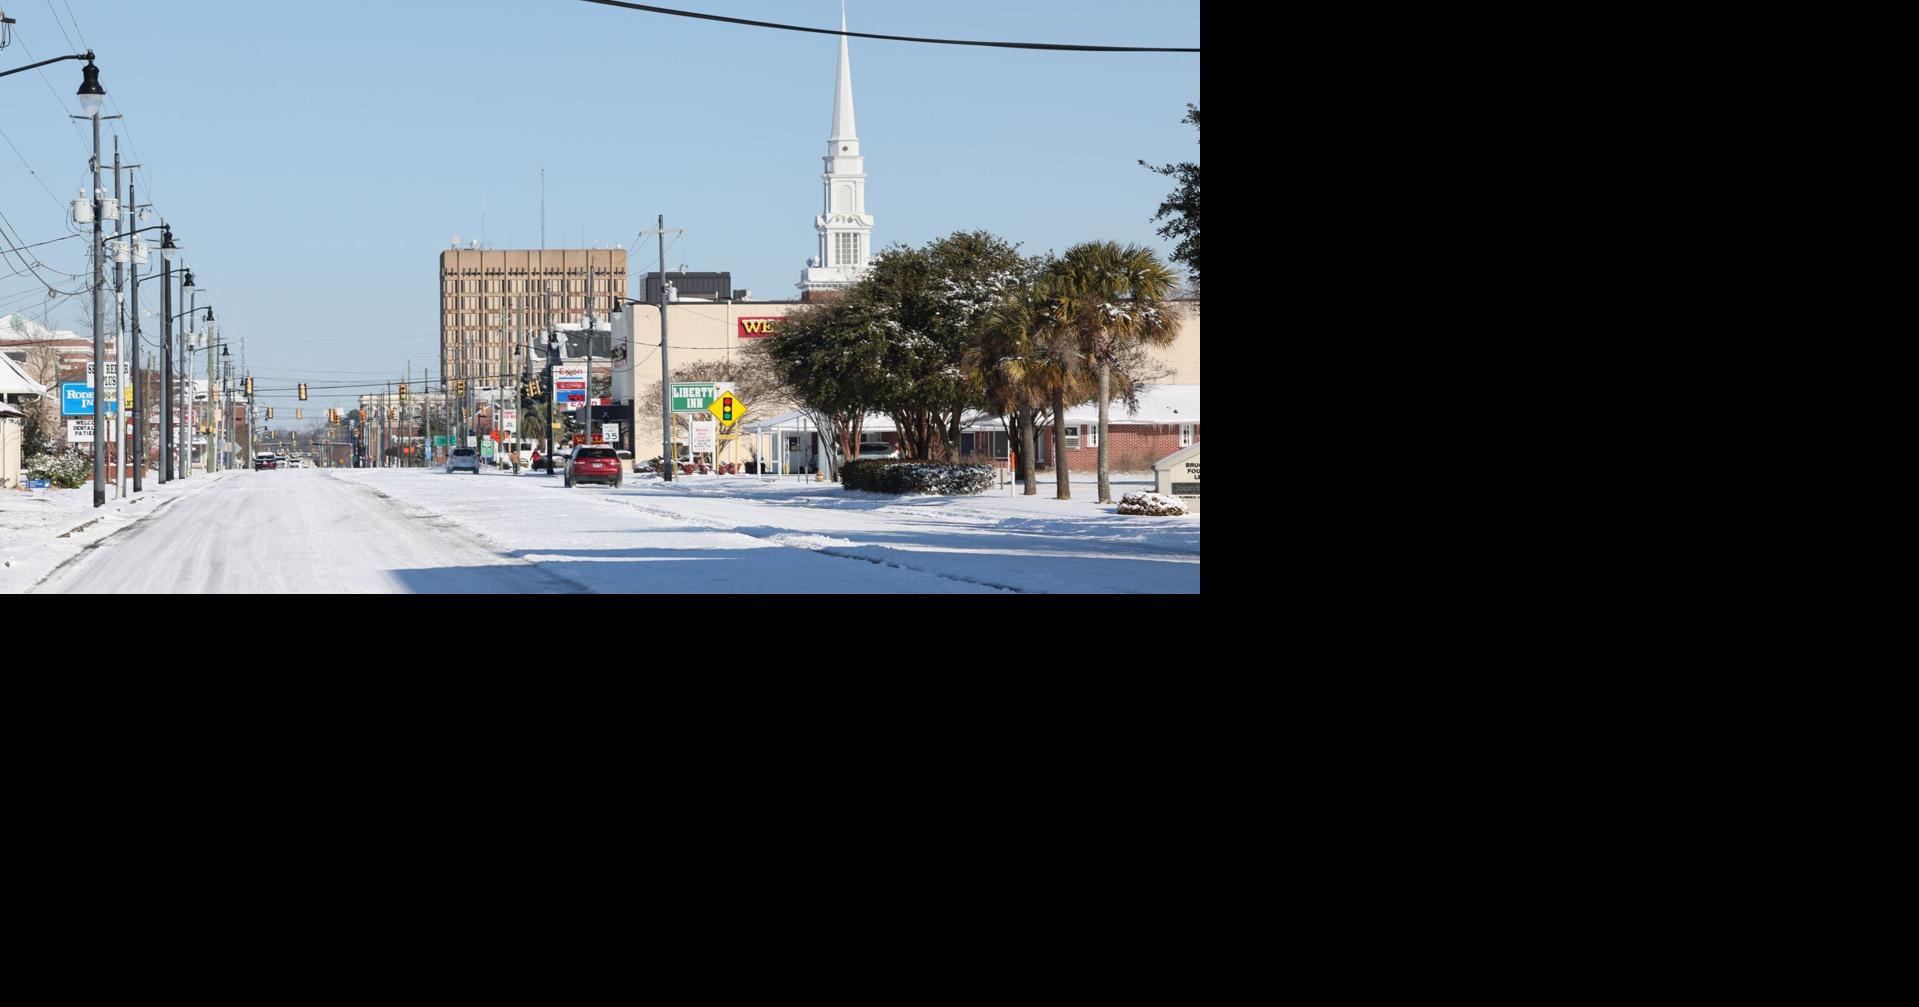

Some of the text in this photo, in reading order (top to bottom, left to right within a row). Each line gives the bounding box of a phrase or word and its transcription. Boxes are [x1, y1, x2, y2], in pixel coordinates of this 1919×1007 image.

[742, 319, 774, 333] WE
[673, 387, 713, 398] LIBERTY
[81, 400, 95, 408] IN
[687, 398, 703, 408] INN
[605, 432, 618, 440] 35
